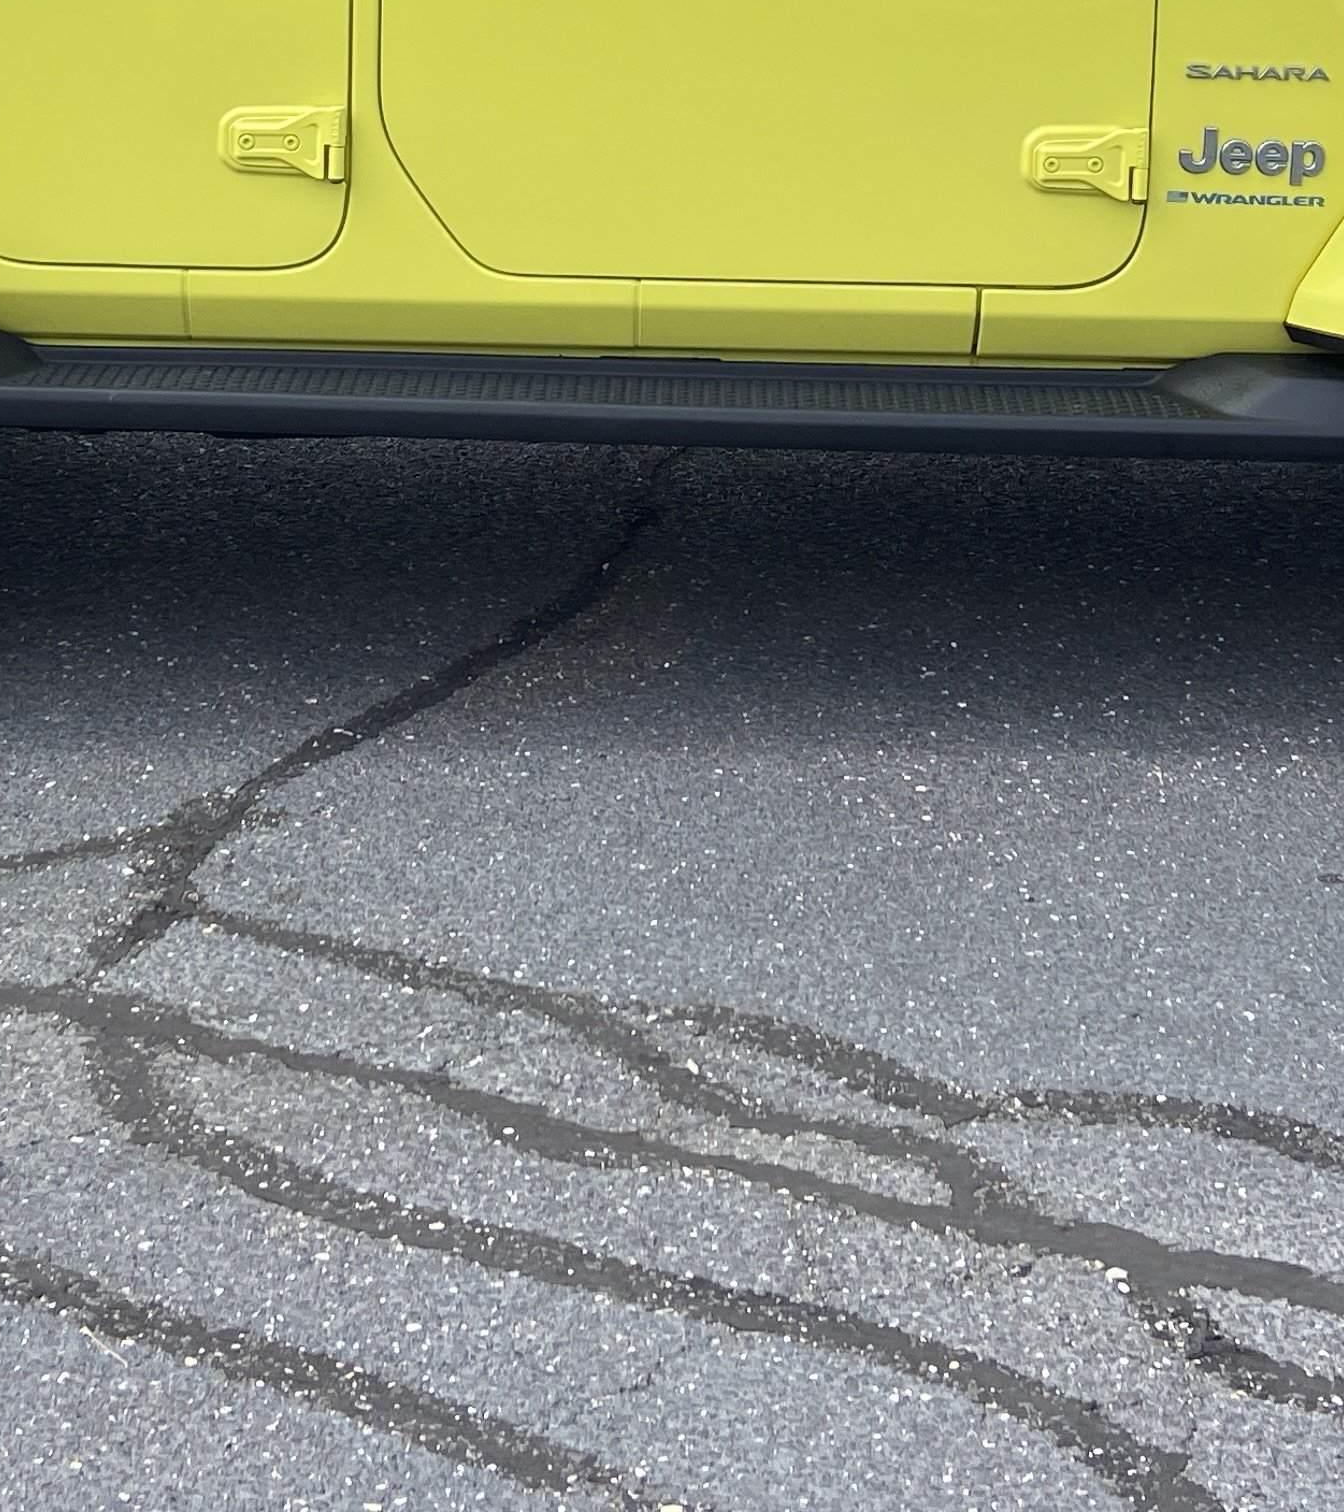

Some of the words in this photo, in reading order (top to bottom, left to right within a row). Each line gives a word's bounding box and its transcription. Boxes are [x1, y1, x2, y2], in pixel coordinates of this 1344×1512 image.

[1185, 63, 1330, 82] SAHARA
[1178, 125, 1325, 186] Jeep
[1191, 191, 1325, 207] WRANGLER
